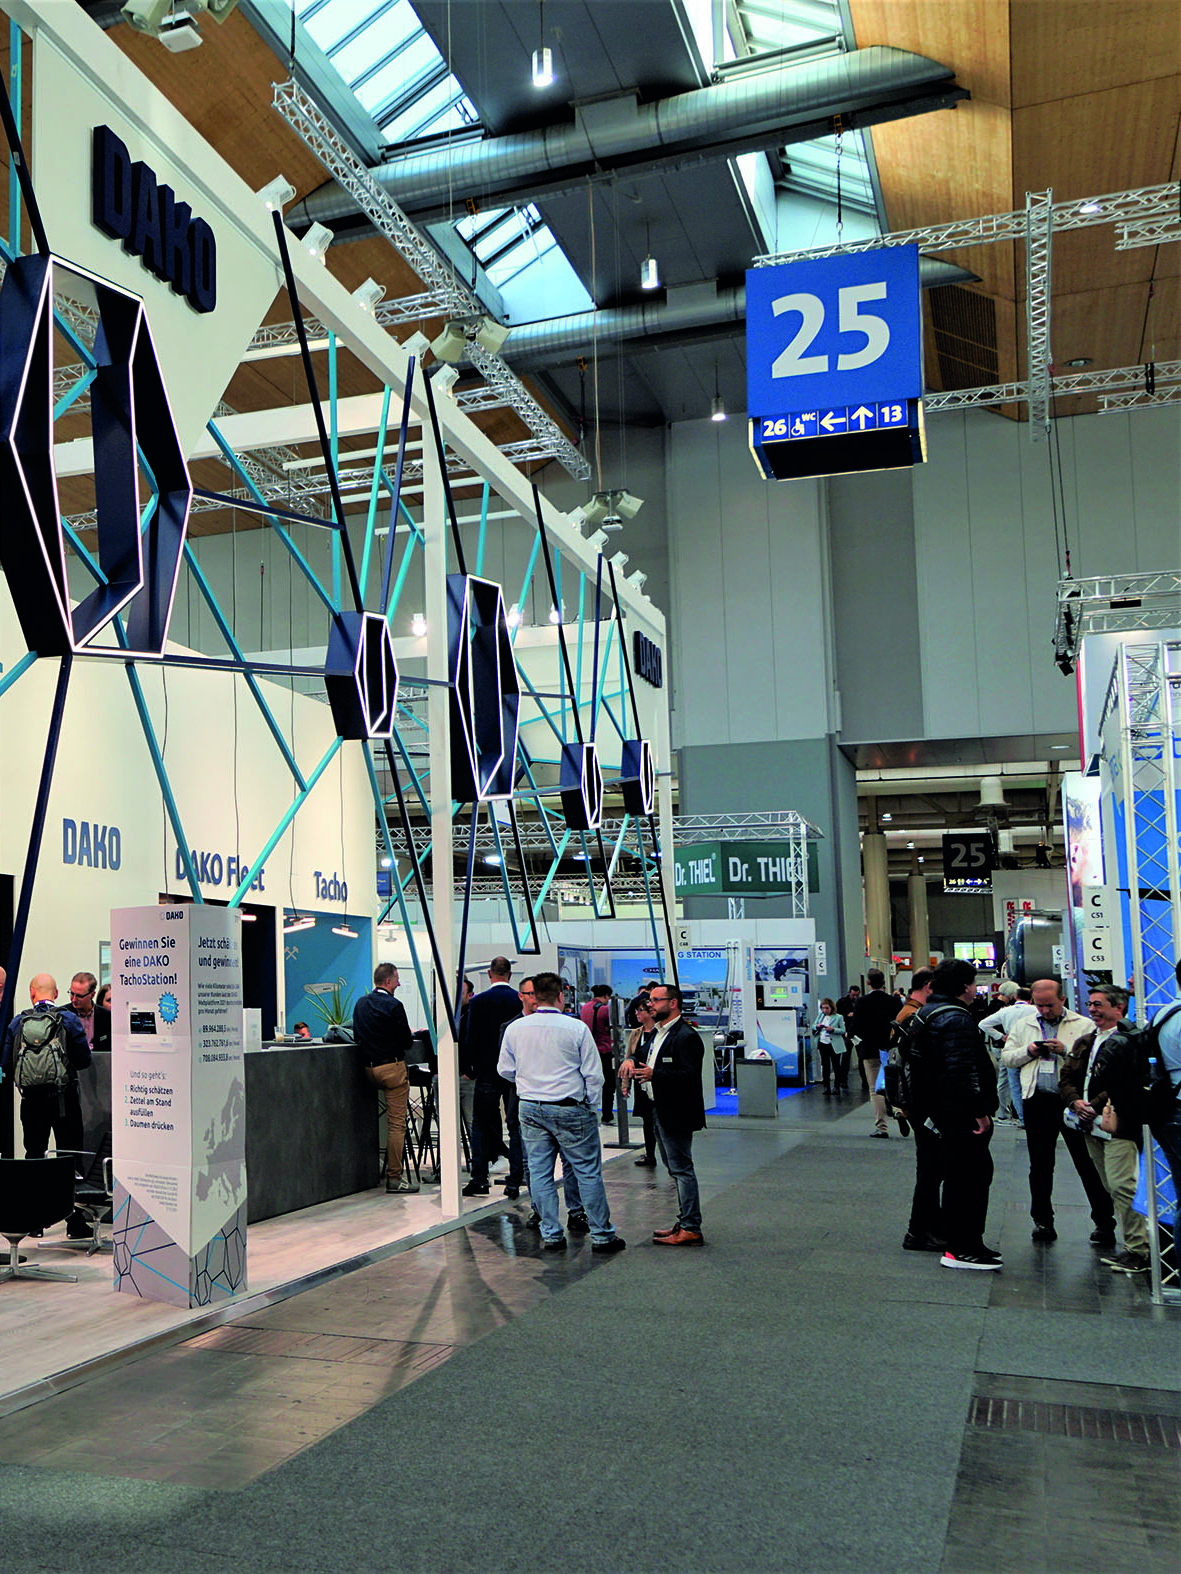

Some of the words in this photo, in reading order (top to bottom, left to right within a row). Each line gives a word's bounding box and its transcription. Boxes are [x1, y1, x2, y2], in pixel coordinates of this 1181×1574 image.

[94, 125, 216, 314] DAKO
[771, 281, 890, 378] 25
[763, 419, 787, 437] 26
[802, 412, 816, 422] WC
[881, 405, 903, 422] 13
[62, 818, 120, 871] DAKO
[950, 843, 986, 867] 25
[176, 848, 223, 886] DAKO
[675, 863, 687, 886] Dr.
[688, 858, 715, 885] THIEL
[729, 857, 752, 882] Dr.
[314, 871, 348, 902] Tacho
[1091, 895, 1101, 907] C
[166, 911, 183, 920] DAKO
[681, 931, 686, 939] C
[119, 938, 159, 950] Gewinnen
[161, 936, 176, 949] Sie
[198, 936, 216, 948] Jetzt
[1092, 938, 1102, 949] C
[124, 956, 141, 968] eine
[143, 954, 169, 967] DAKO
[198, 954, 211, 967] und
[984, 959, 994, 967] 13
[119, 973, 178, 985] TachoStation!
[130, 1085, 148, 1095] Richtig
[130, 1096, 146, 1104] Zettel
[155, 1098, 171, 1106] Stand
[130, 1119, 150, 1128] Daumen
